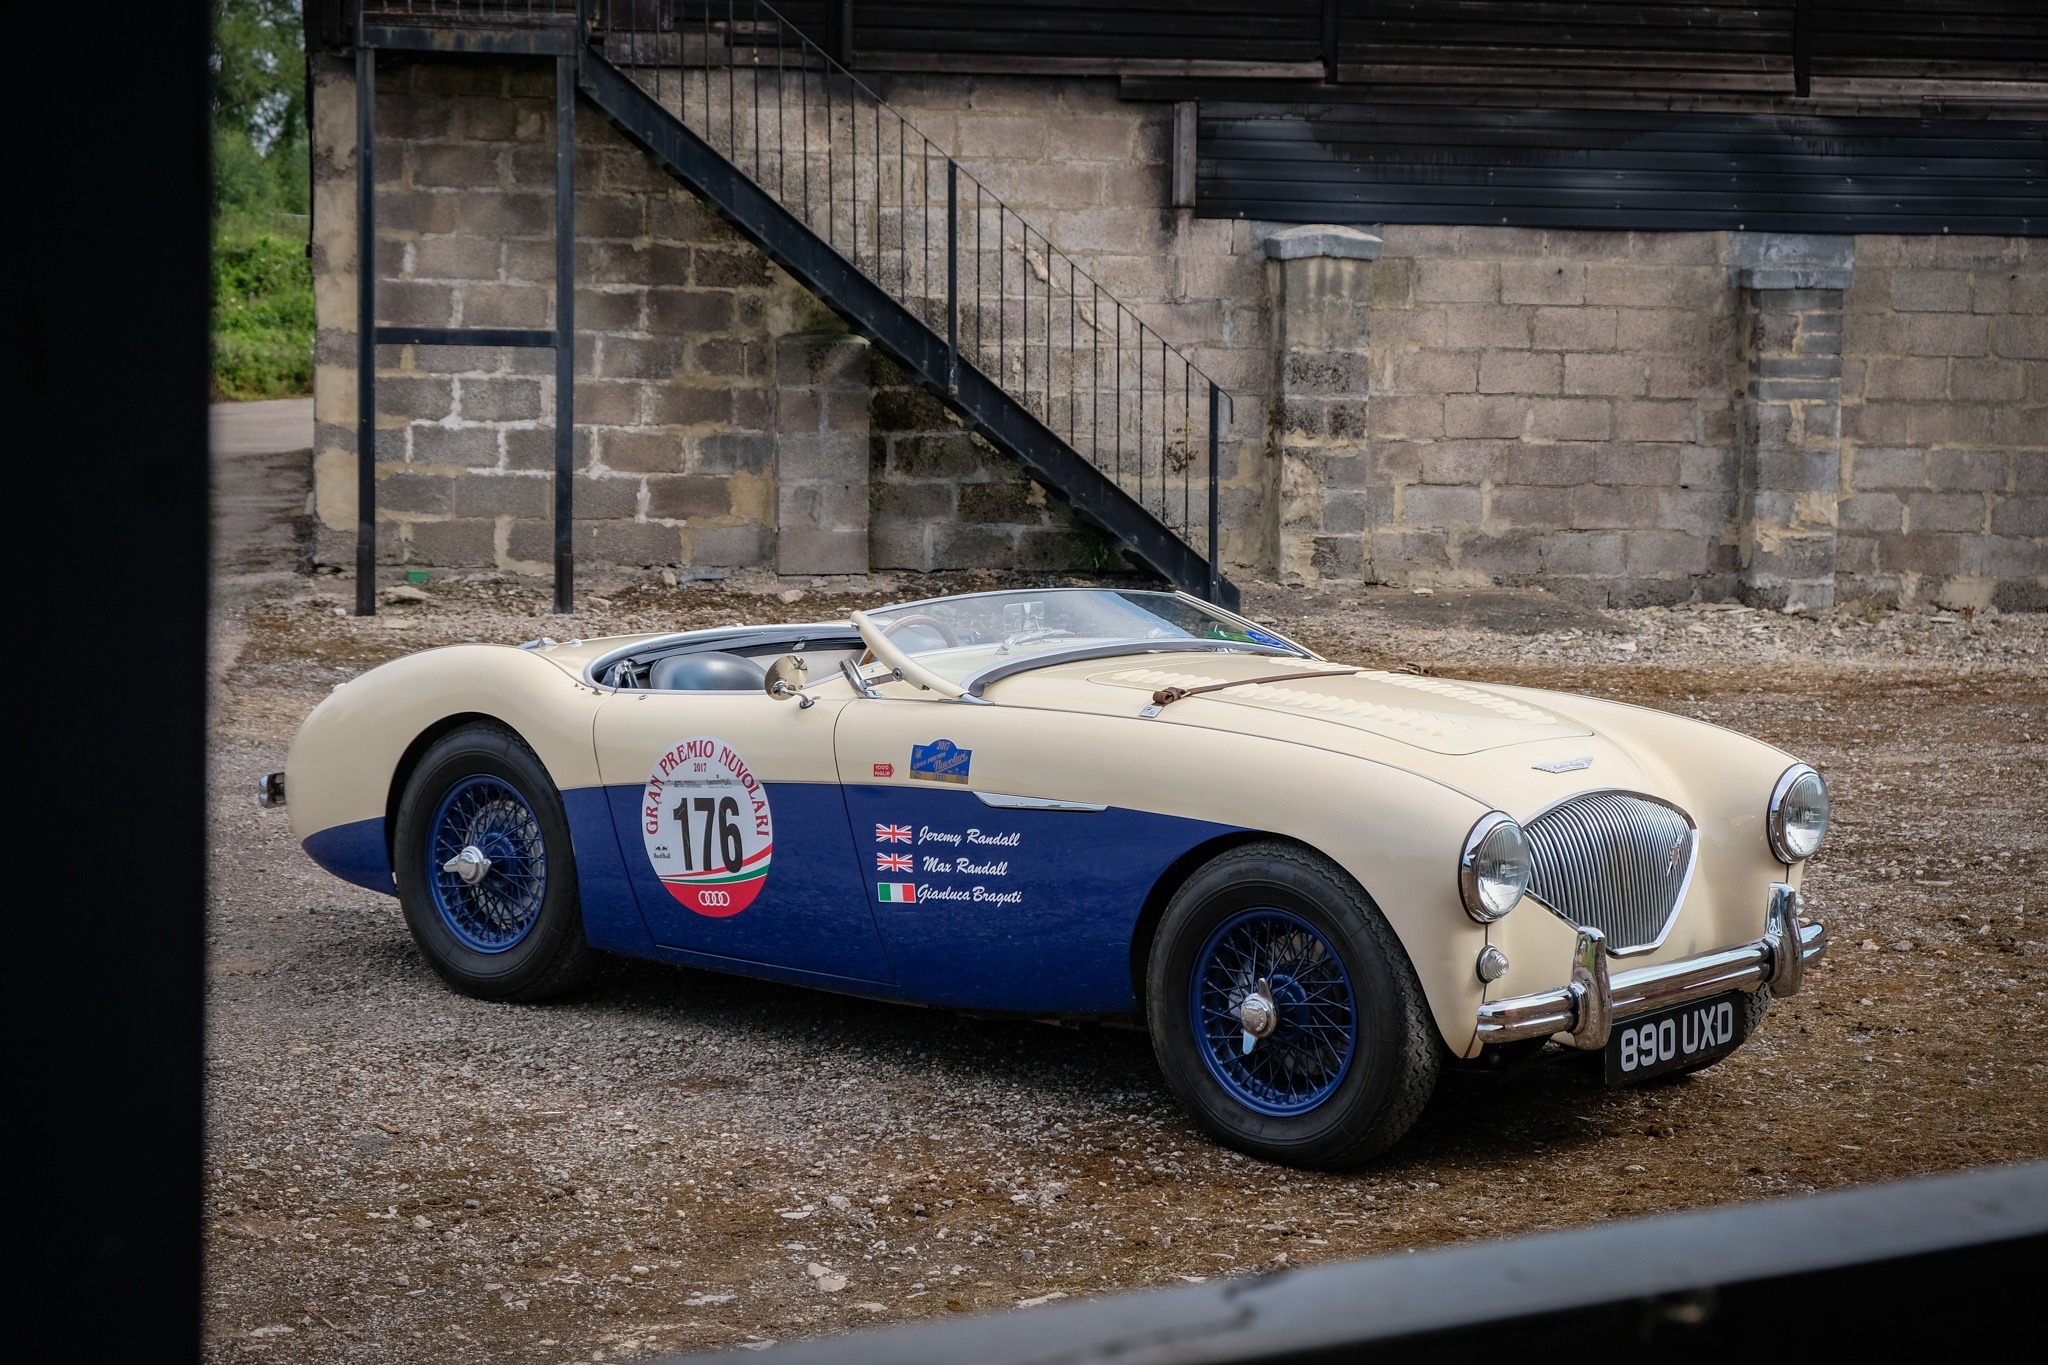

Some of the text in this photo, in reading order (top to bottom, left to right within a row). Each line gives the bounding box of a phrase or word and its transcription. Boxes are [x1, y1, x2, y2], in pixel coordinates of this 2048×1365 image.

[936, 741, 950, 750] 2017
[693, 763, 707, 772] 2017
[646, 740, 769, 836] GRAN PREMIO NUVOLARI
[672, 796, 743, 873] 176
[918, 826, 1020, 846] Jeremy Randall
[923, 856, 1007, 875] Max Randall
[917, 884, 1021, 907] Gianluca Braguti
[1621, 1002, 1733, 1072] 890 UXD
